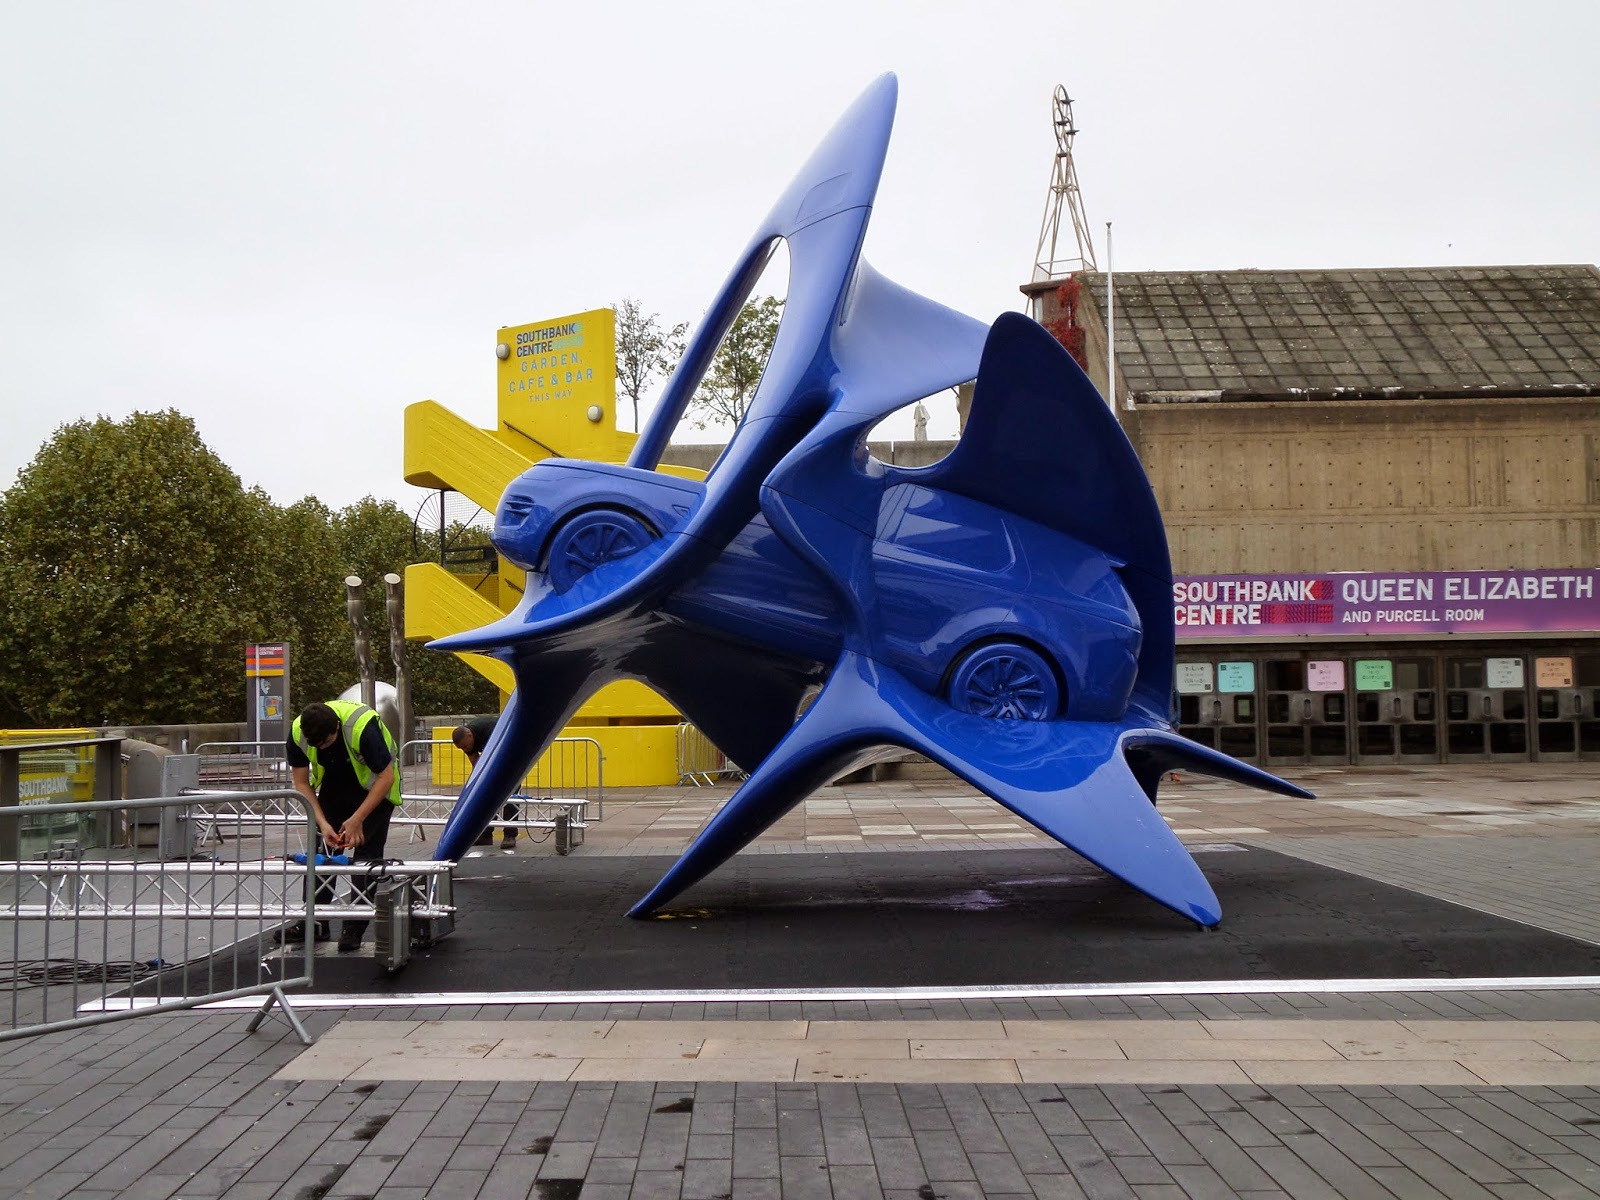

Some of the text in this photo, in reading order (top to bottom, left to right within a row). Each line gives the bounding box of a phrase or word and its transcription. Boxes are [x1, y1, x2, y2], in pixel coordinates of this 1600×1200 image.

[516, 323, 575, 344] SOUTHBANK
[517, 341, 553, 358] CENTRE
[521, 352, 582, 373] GARDEN,
[509, 368, 593, 393] CAFE & BAR
[529, 389, 573, 402] THIS WAY
[1173, 580, 1316, 603] SOUTHBANK
[1342, 576, 1594, 605] QUEEN ELIZABETH
[1174, 604, 1262, 626] CENTRE
[1342, 608, 1485, 623] AND PURCELL ROOM
[19, 776, 68, 798] SOUTHBANK
